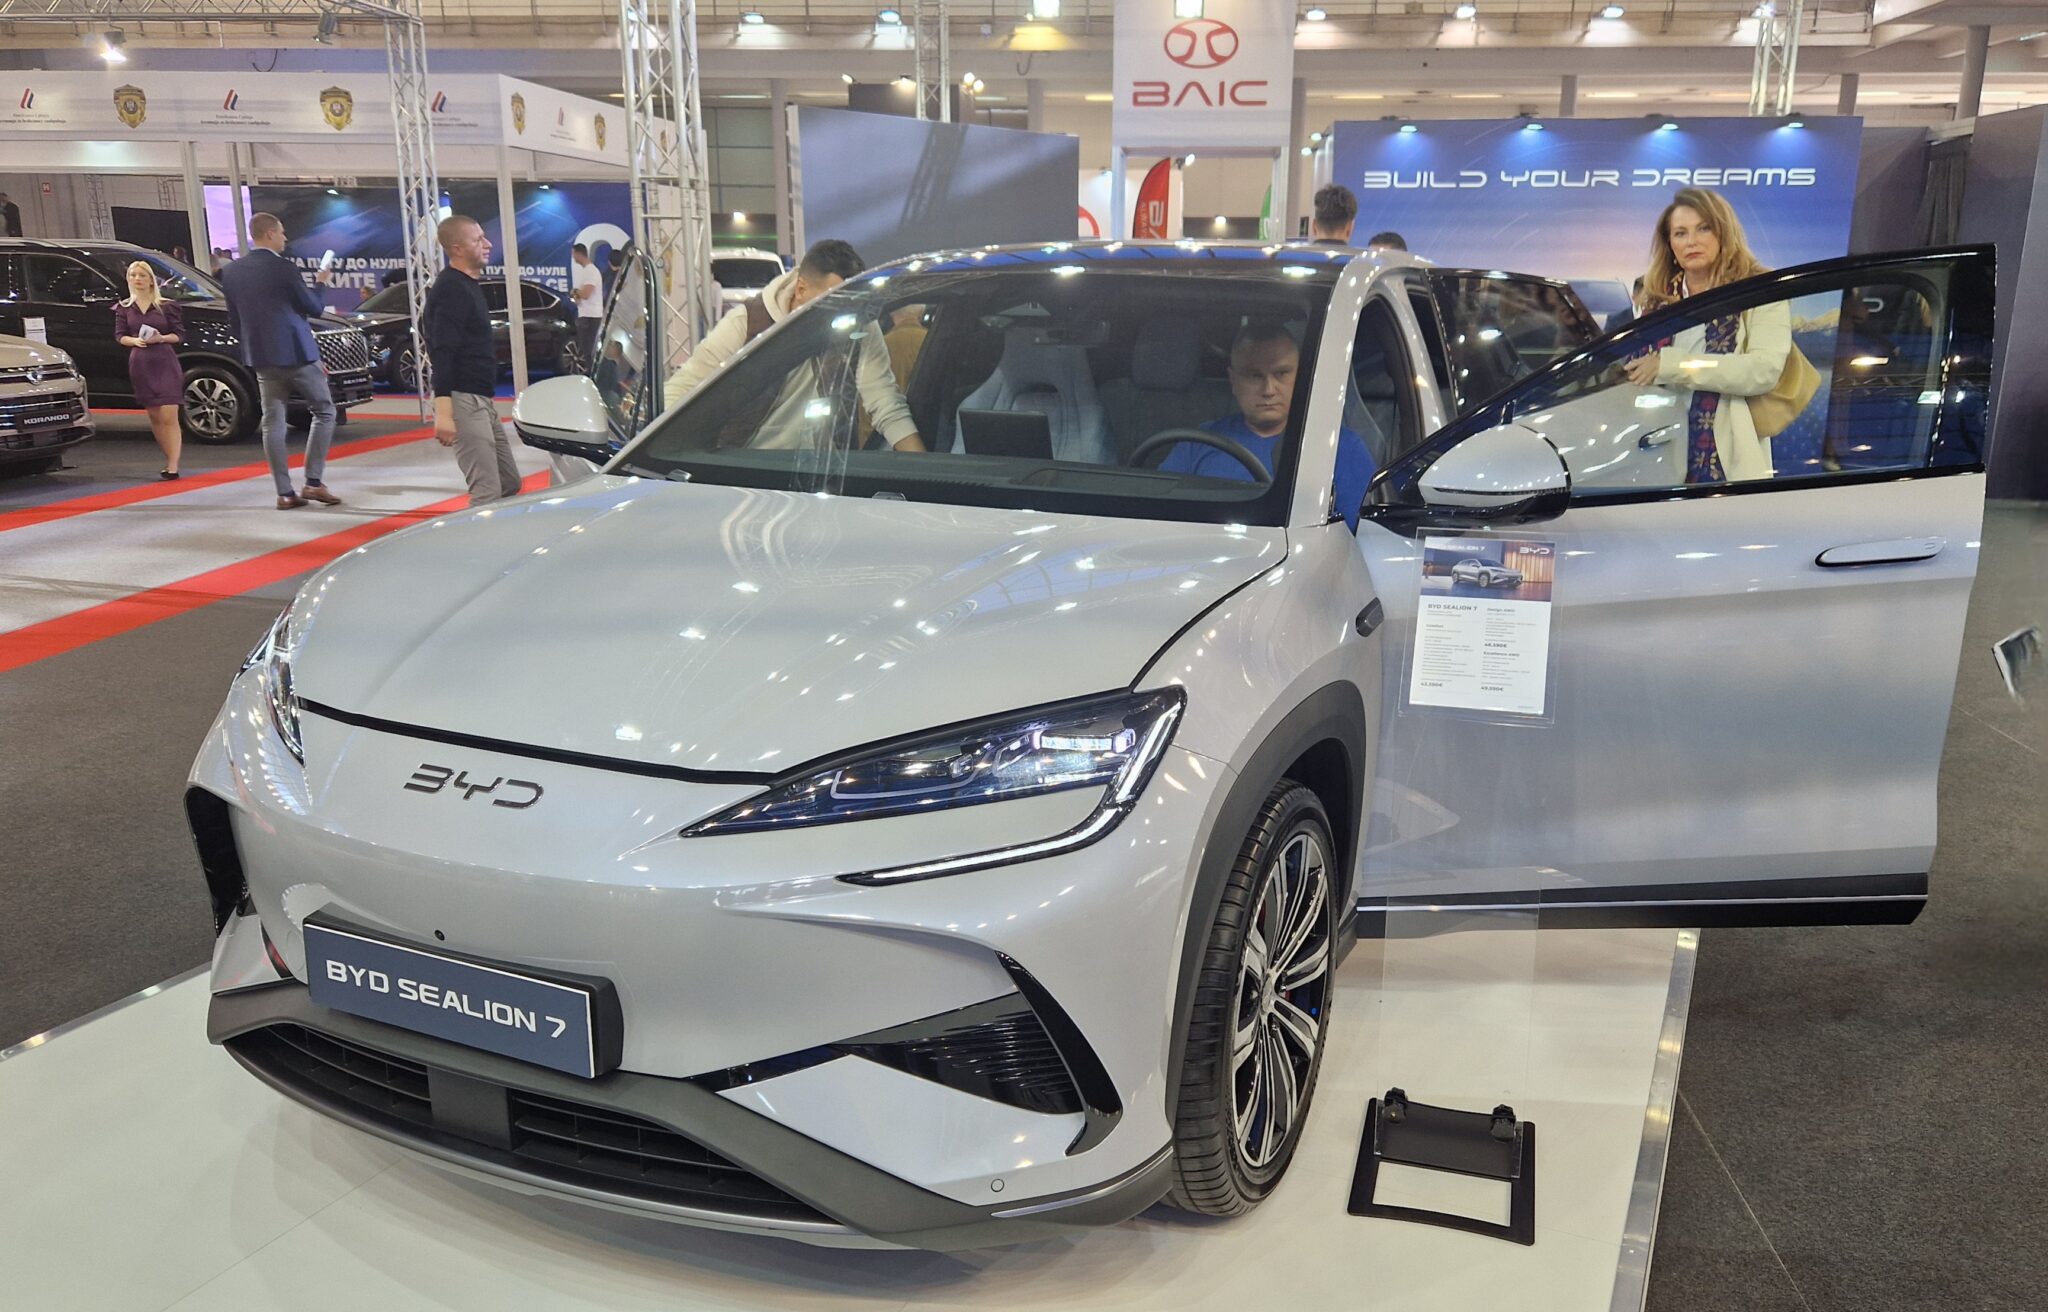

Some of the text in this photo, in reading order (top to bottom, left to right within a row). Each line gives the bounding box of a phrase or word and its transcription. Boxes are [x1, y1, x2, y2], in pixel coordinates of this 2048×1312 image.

[1132, 81, 1268, 107] BAIC
[1364, 167, 1816, 189] BUILD YOUR DREAMS
[345, 258, 367, 270] ДО
[370, 258, 407, 269] НУЛЕ
[537, 267, 567, 276] НУЛЕ
[24, 414, 70, 425] KORANDO
[403, 763, 544, 809] BYD
[325, 959, 566, 1039] BYD SEALION 7
